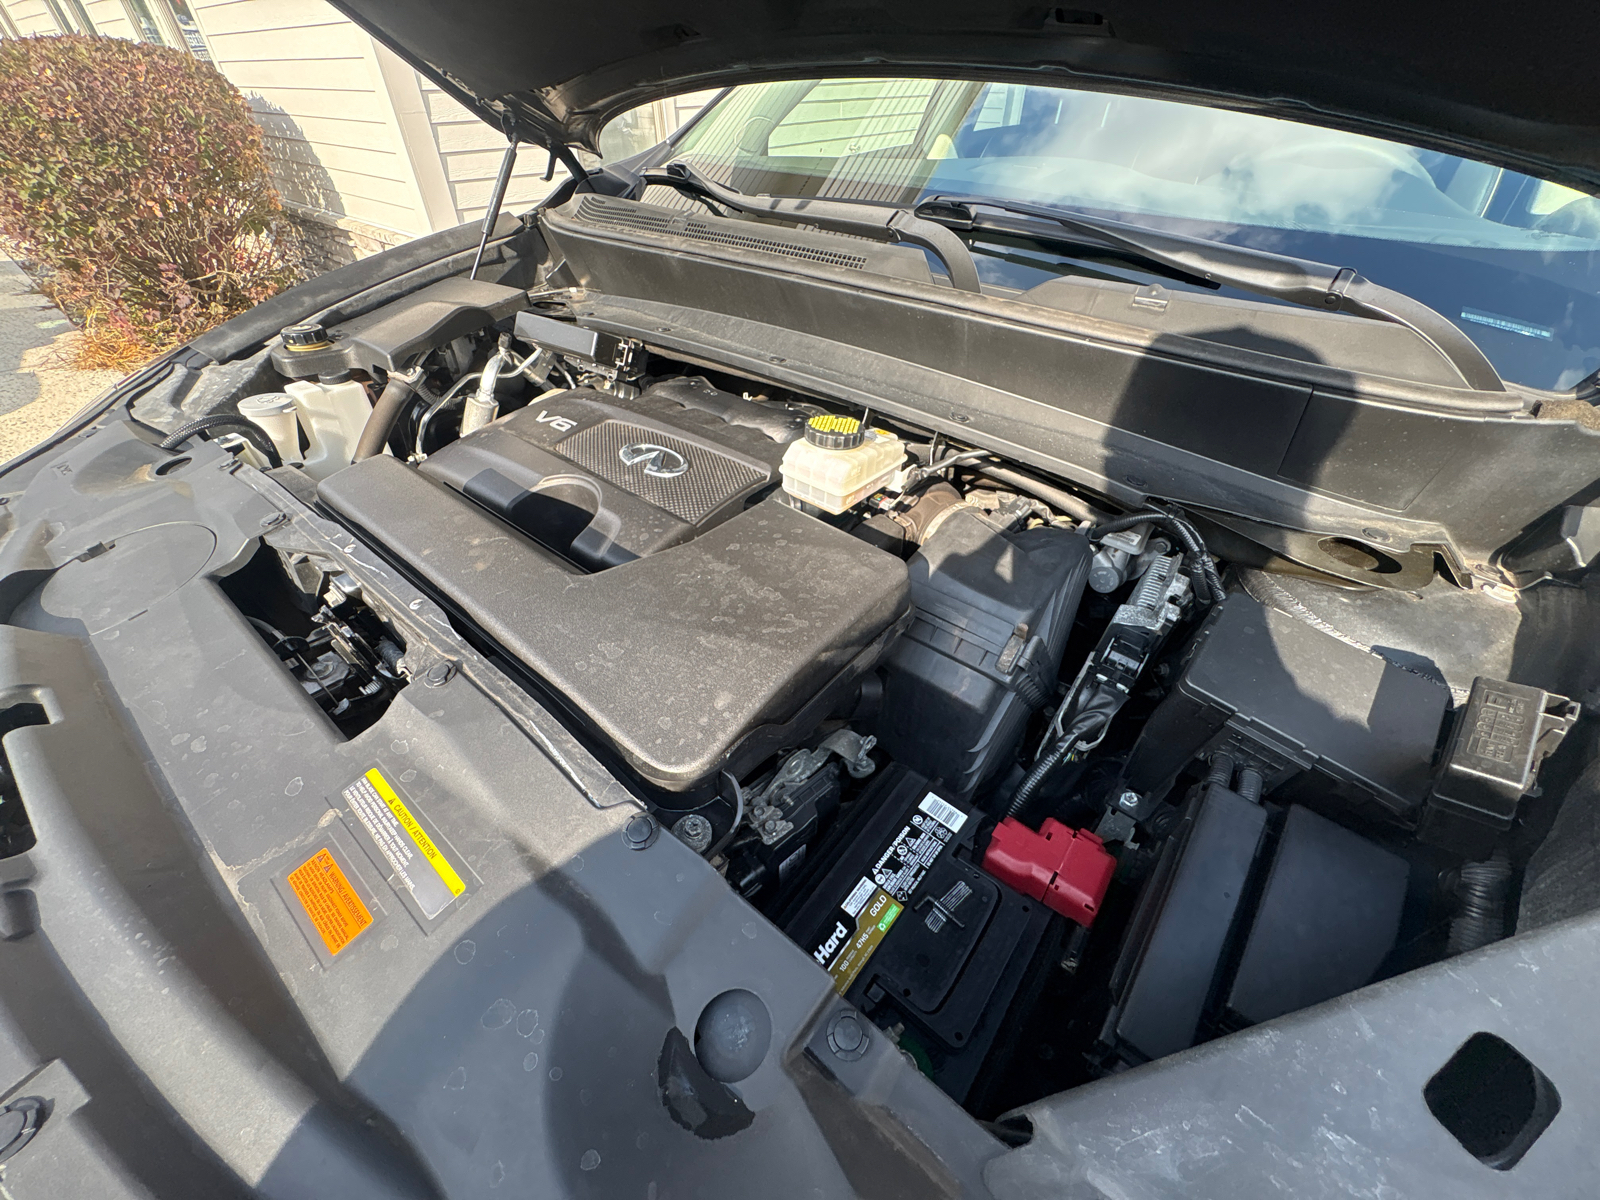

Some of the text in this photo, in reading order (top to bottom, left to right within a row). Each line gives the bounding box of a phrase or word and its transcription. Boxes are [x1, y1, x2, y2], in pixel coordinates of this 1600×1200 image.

[535, 409, 578, 432] V6
[392, 803, 413, 828] CAUTION
[411, 828, 437, 859] ATTENTION
[875, 825, 911, 868] DANGER/POISON
[328, 871, 345, 893] WARNING
[341, 891, 367, 927] AVERTISSEMENT
[869, 894, 887, 917] GOLD
[813, 921, 848, 965] Hard
